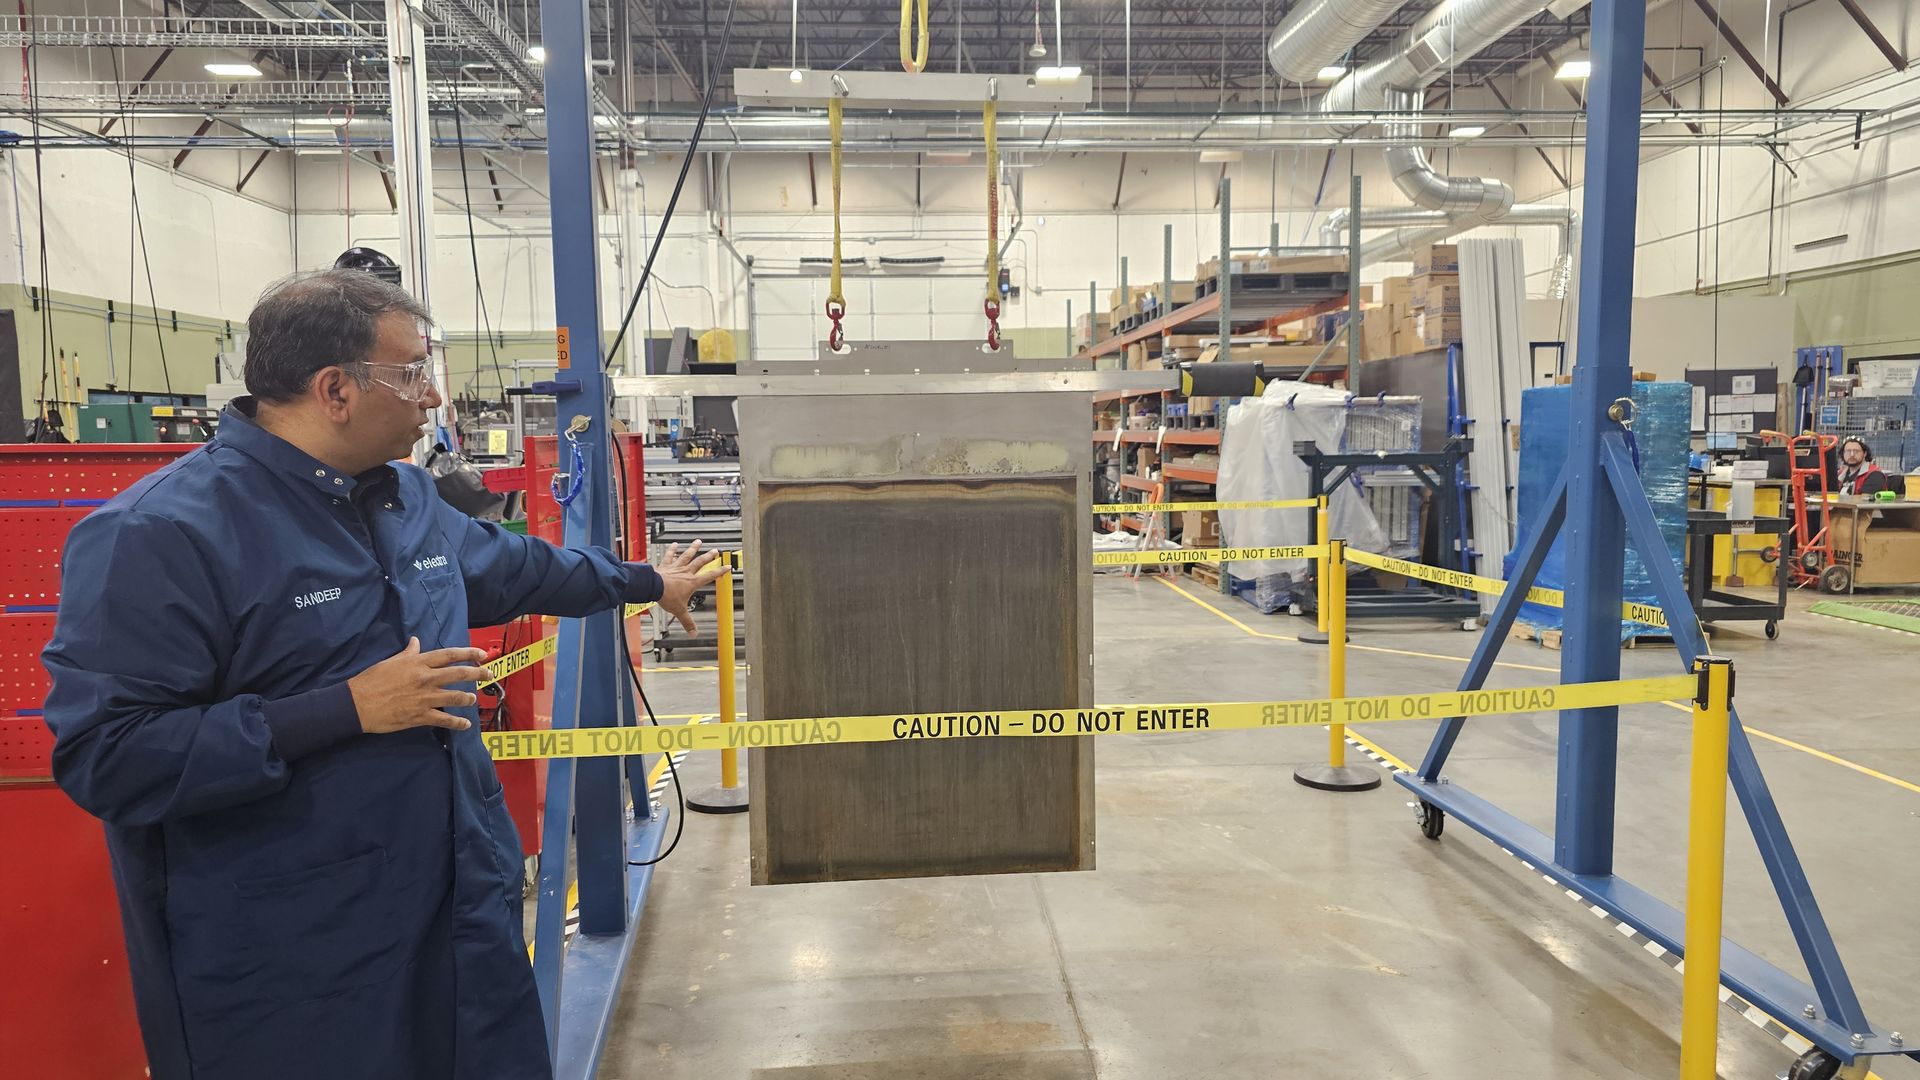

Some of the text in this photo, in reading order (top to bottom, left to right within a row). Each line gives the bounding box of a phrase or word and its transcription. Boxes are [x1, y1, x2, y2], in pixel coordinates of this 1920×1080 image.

[1093, 505, 1116, 513] UTION
[1124, 504, 1134, 512] DO
[1136, 504, 1150, 512] NOT
[1152, 503, 1174, 511] ENTER
[1159, 551, 1207, 562] CAUTION
[1221, 550, 1237, 560] DO
[1242, 548, 1265, 559] NOT
[1270, 547, 1304, 558] ENTER
[1382, 557, 1411, 574] CAUTION
[1418, 566, 1429, 577] DO
[1431, 569, 1447, 582] NOT
[1449, 573, 1474, 588] ENTER
[294, 587, 342, 610] SANDEEP
[1632, 605, 1668, 626] CAUTIO
[506, 648, 530, 674] ENTER
[893, 714, 1000, 739] CAUTION
[1032, 712, 1065, 734] DO
[1077, 710, 1125, 732] NOT
[1137, 708, 1210, 731] ENTER
